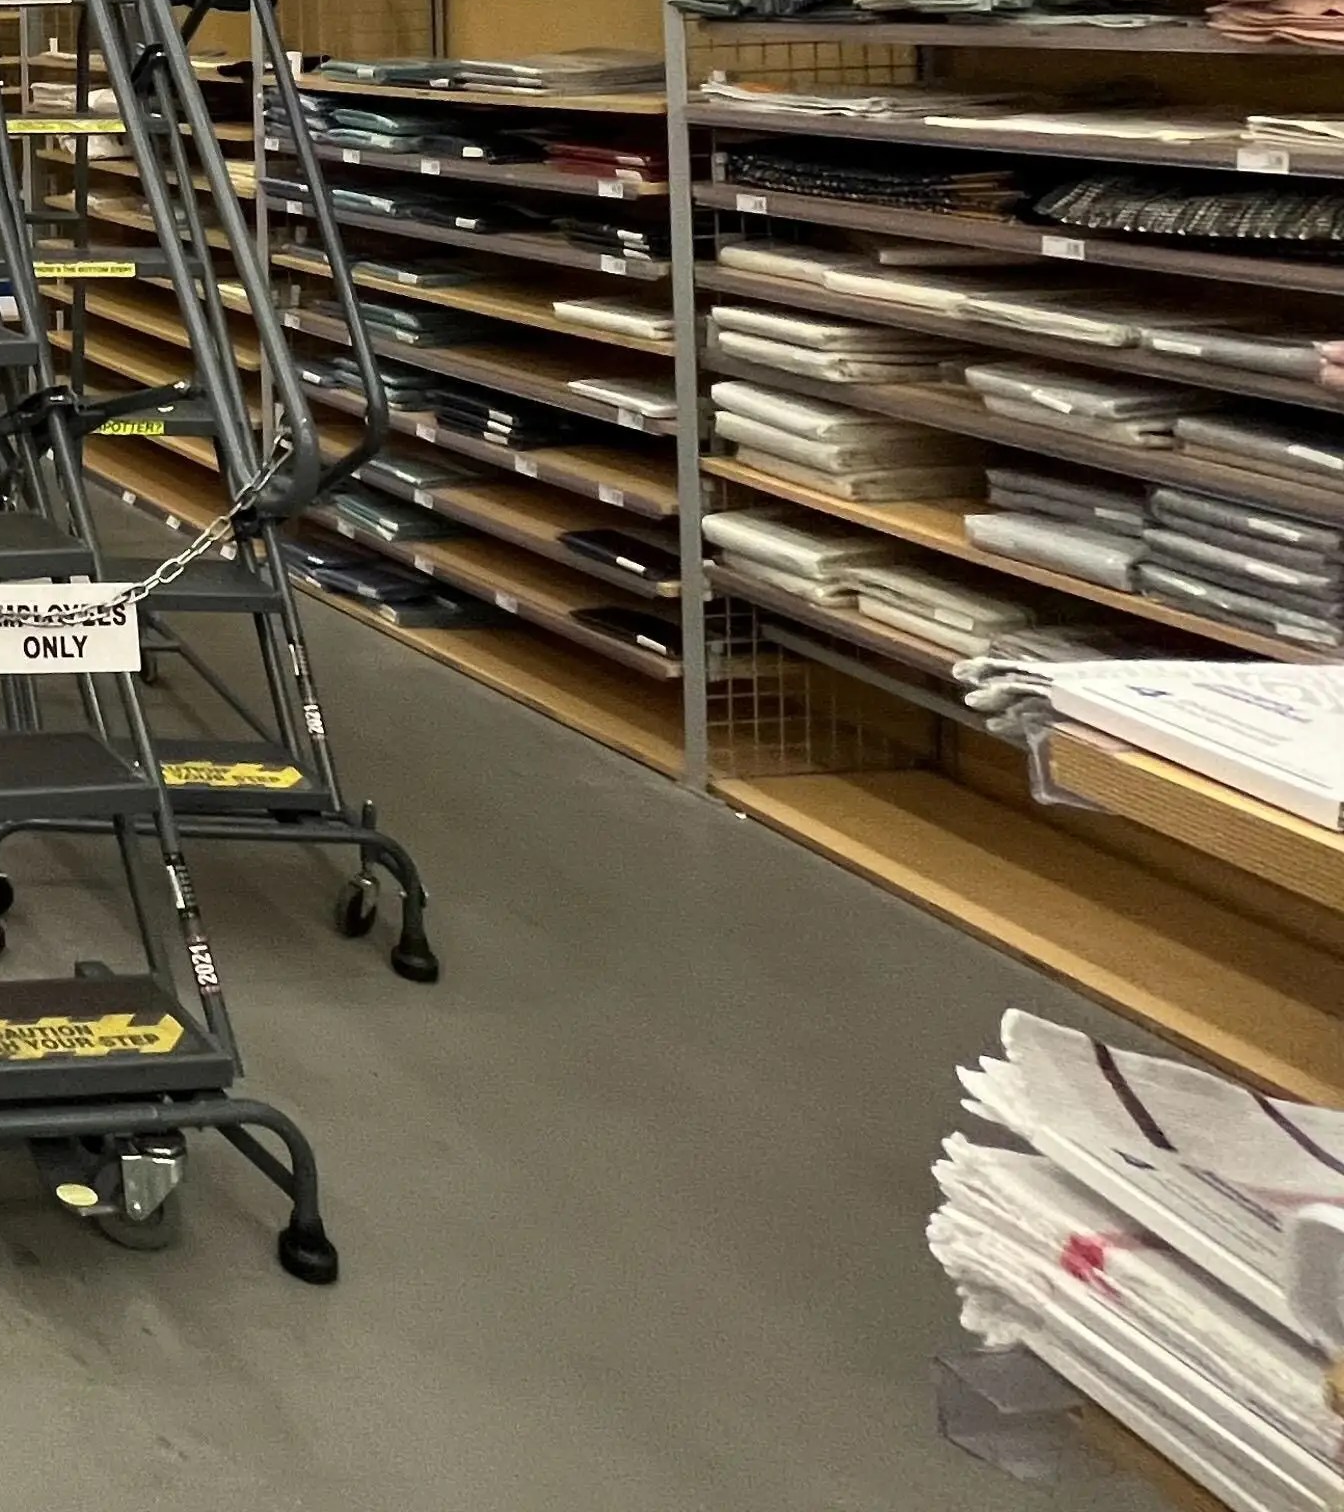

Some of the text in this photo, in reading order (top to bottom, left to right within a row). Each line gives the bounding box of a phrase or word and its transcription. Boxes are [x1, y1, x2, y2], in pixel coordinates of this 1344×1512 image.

[98, 420, 163, 434] POTTER?
[23, 635, 88, 659] ONLY
[188, 944, 219, 986] 2021
[24, 1036, 96, 1052] YOUR
[97, 1032, 161, 1048] STEP
